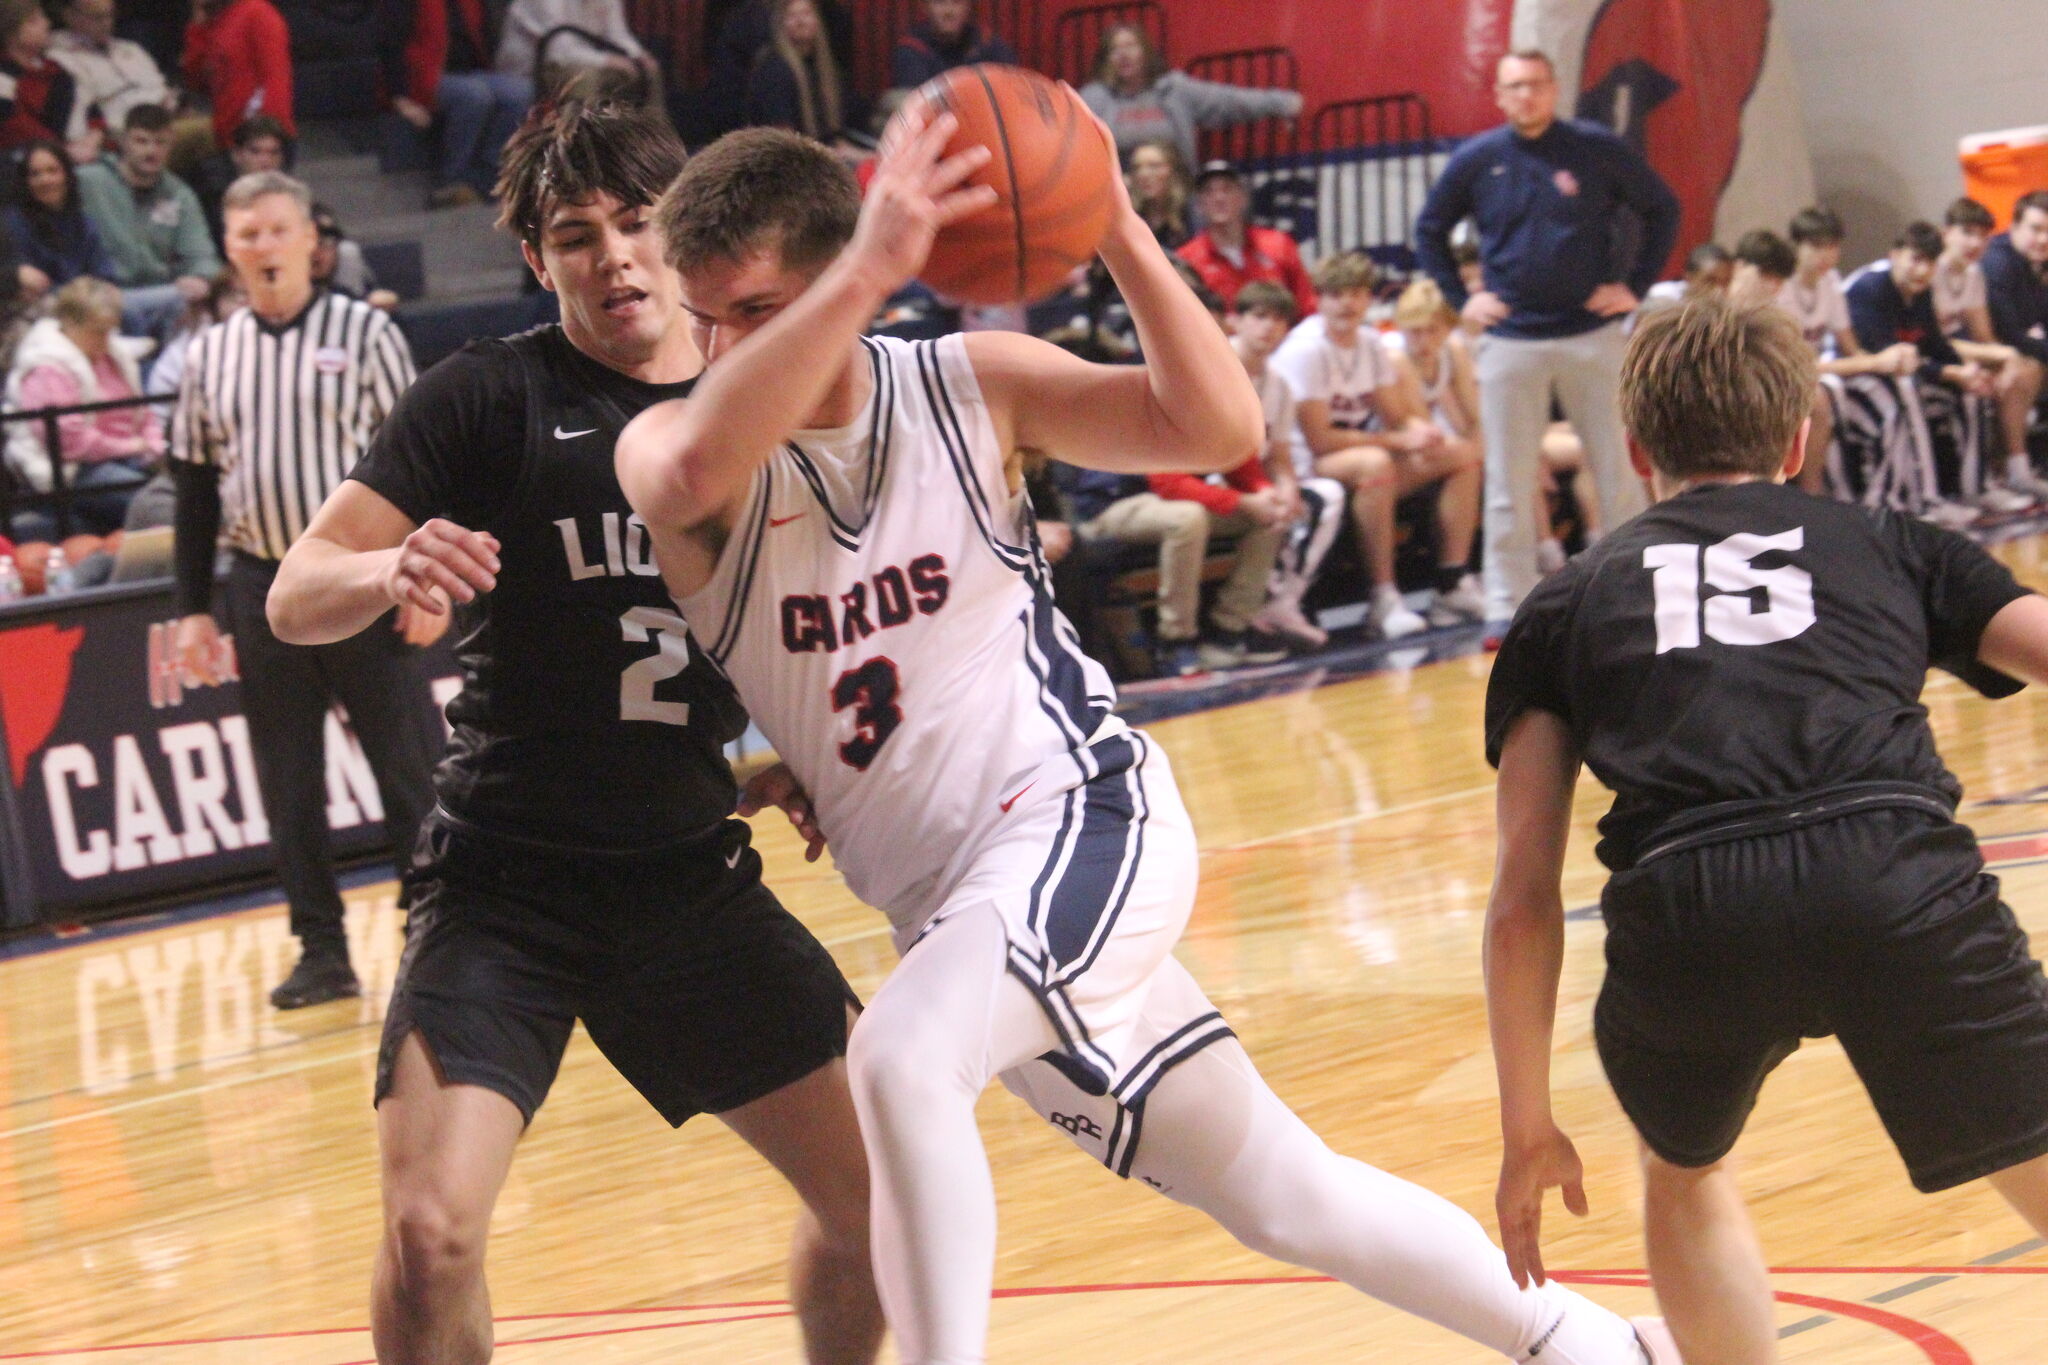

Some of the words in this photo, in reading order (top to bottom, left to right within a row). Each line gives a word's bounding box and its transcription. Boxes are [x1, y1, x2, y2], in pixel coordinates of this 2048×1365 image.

[553, 512, 661, 581] LIO
[781, 552, 951, 653] CARDS
[1643, 525, 1817, 656] 15
[619, 605, 690, 726] 2
[830, 655, 904, 772] 3
